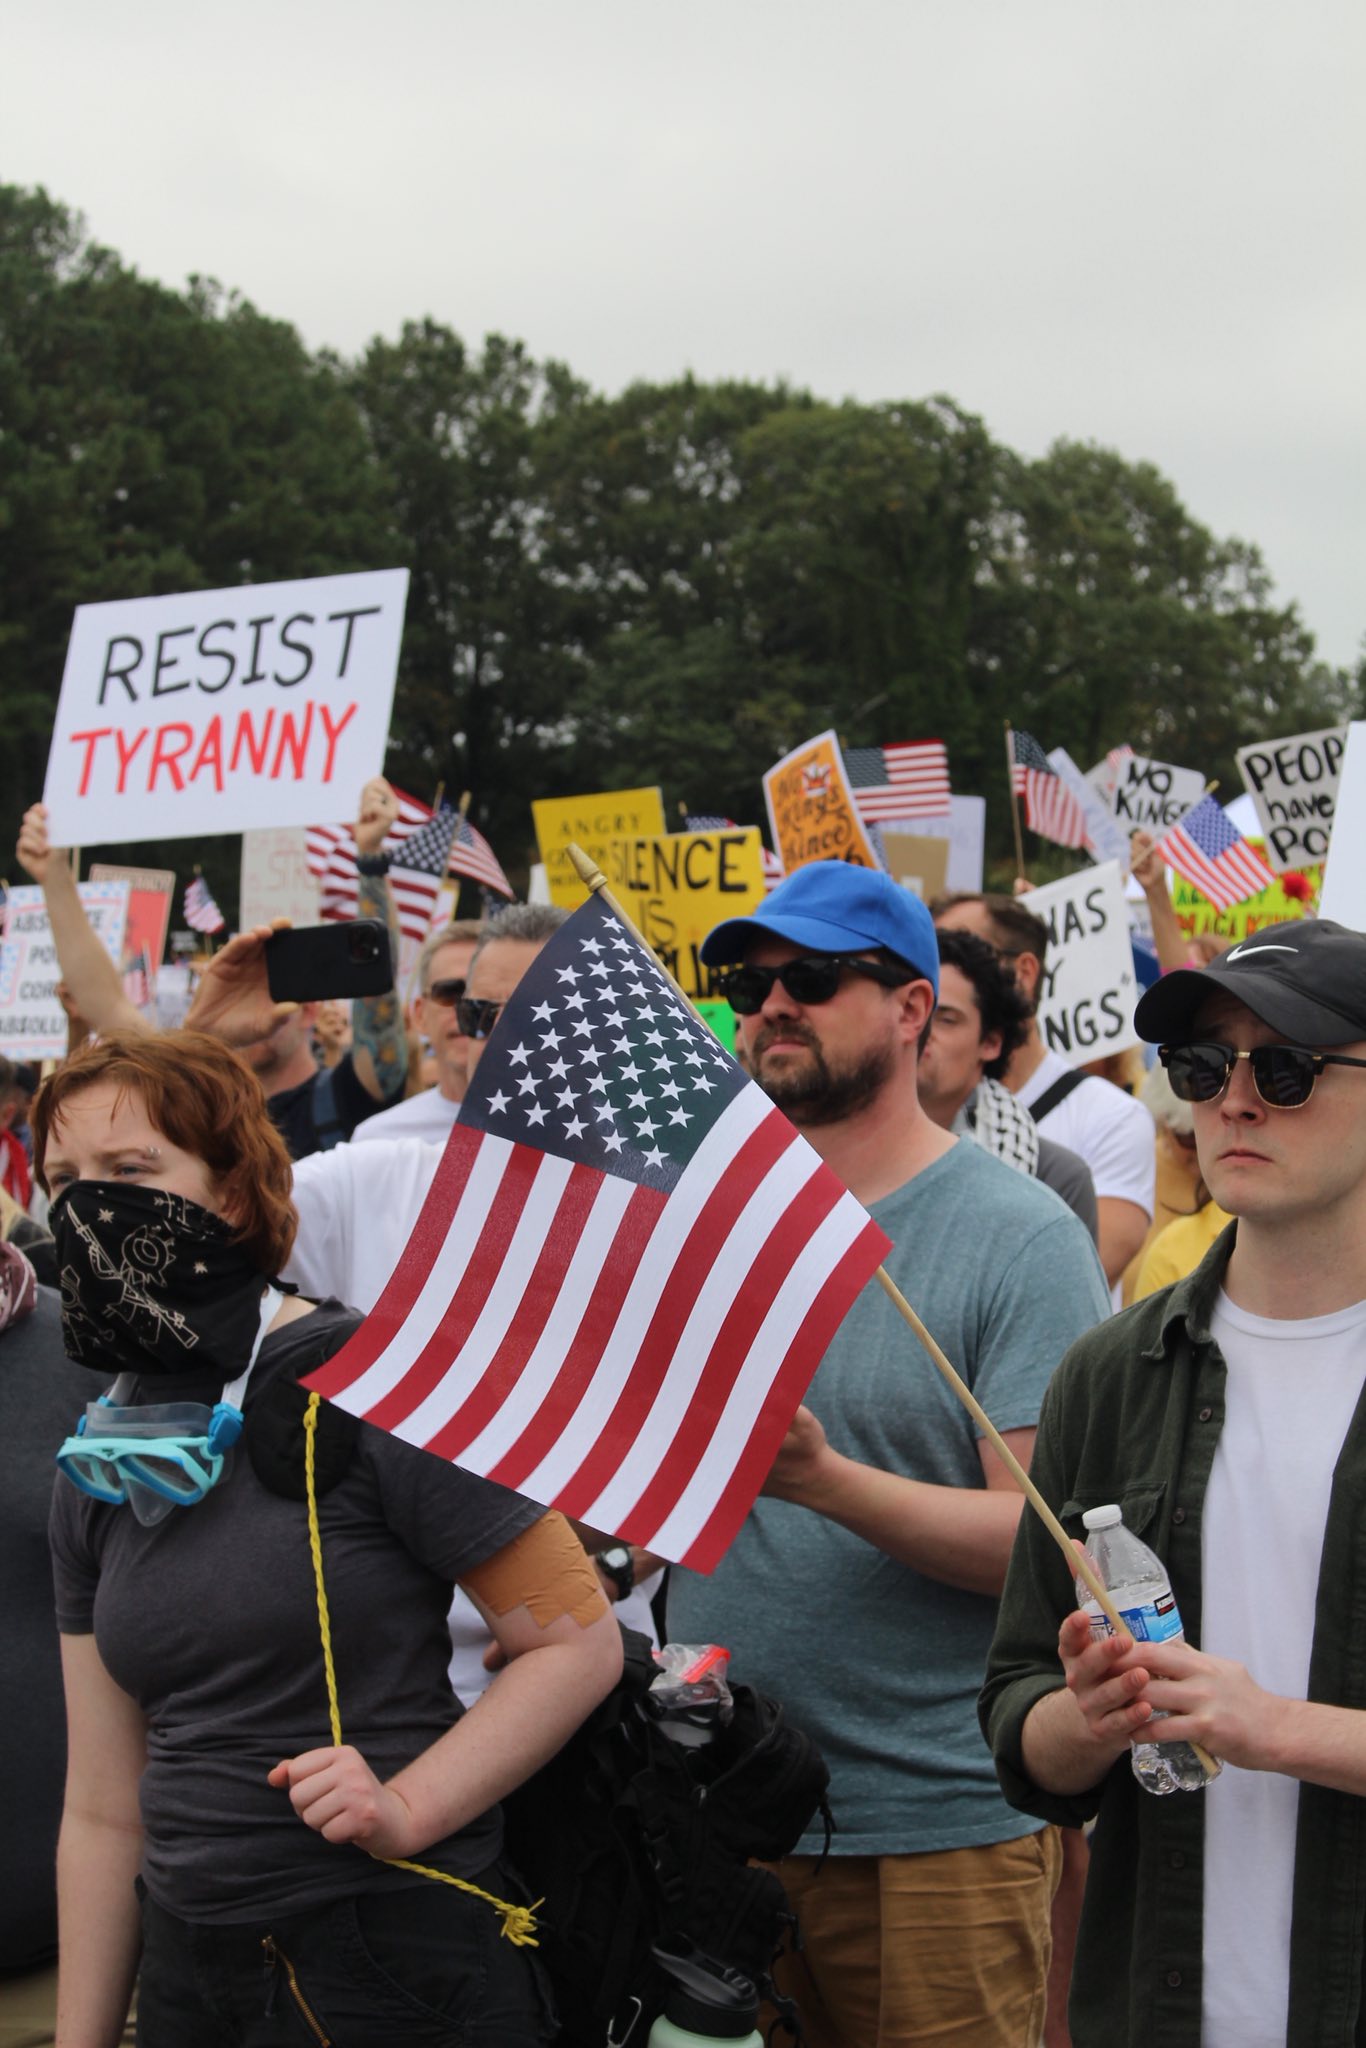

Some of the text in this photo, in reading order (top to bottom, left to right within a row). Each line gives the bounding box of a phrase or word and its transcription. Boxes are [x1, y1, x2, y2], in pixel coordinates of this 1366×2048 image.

[97, 605, 382, 705] RESIST
[70, 700, 358, 798] TYRANNY
[1245, 733, 1346, 792] PEOP
[1128, 760, 1172, 794] NO
[560, 814, 641, 836] ANGRY
[1264, 794, 1335, 822] have
[610, 836, 748, 893] SILENCE
[1269, 824, 1332, 863] PO
[638, 896, 677, 946] IS
